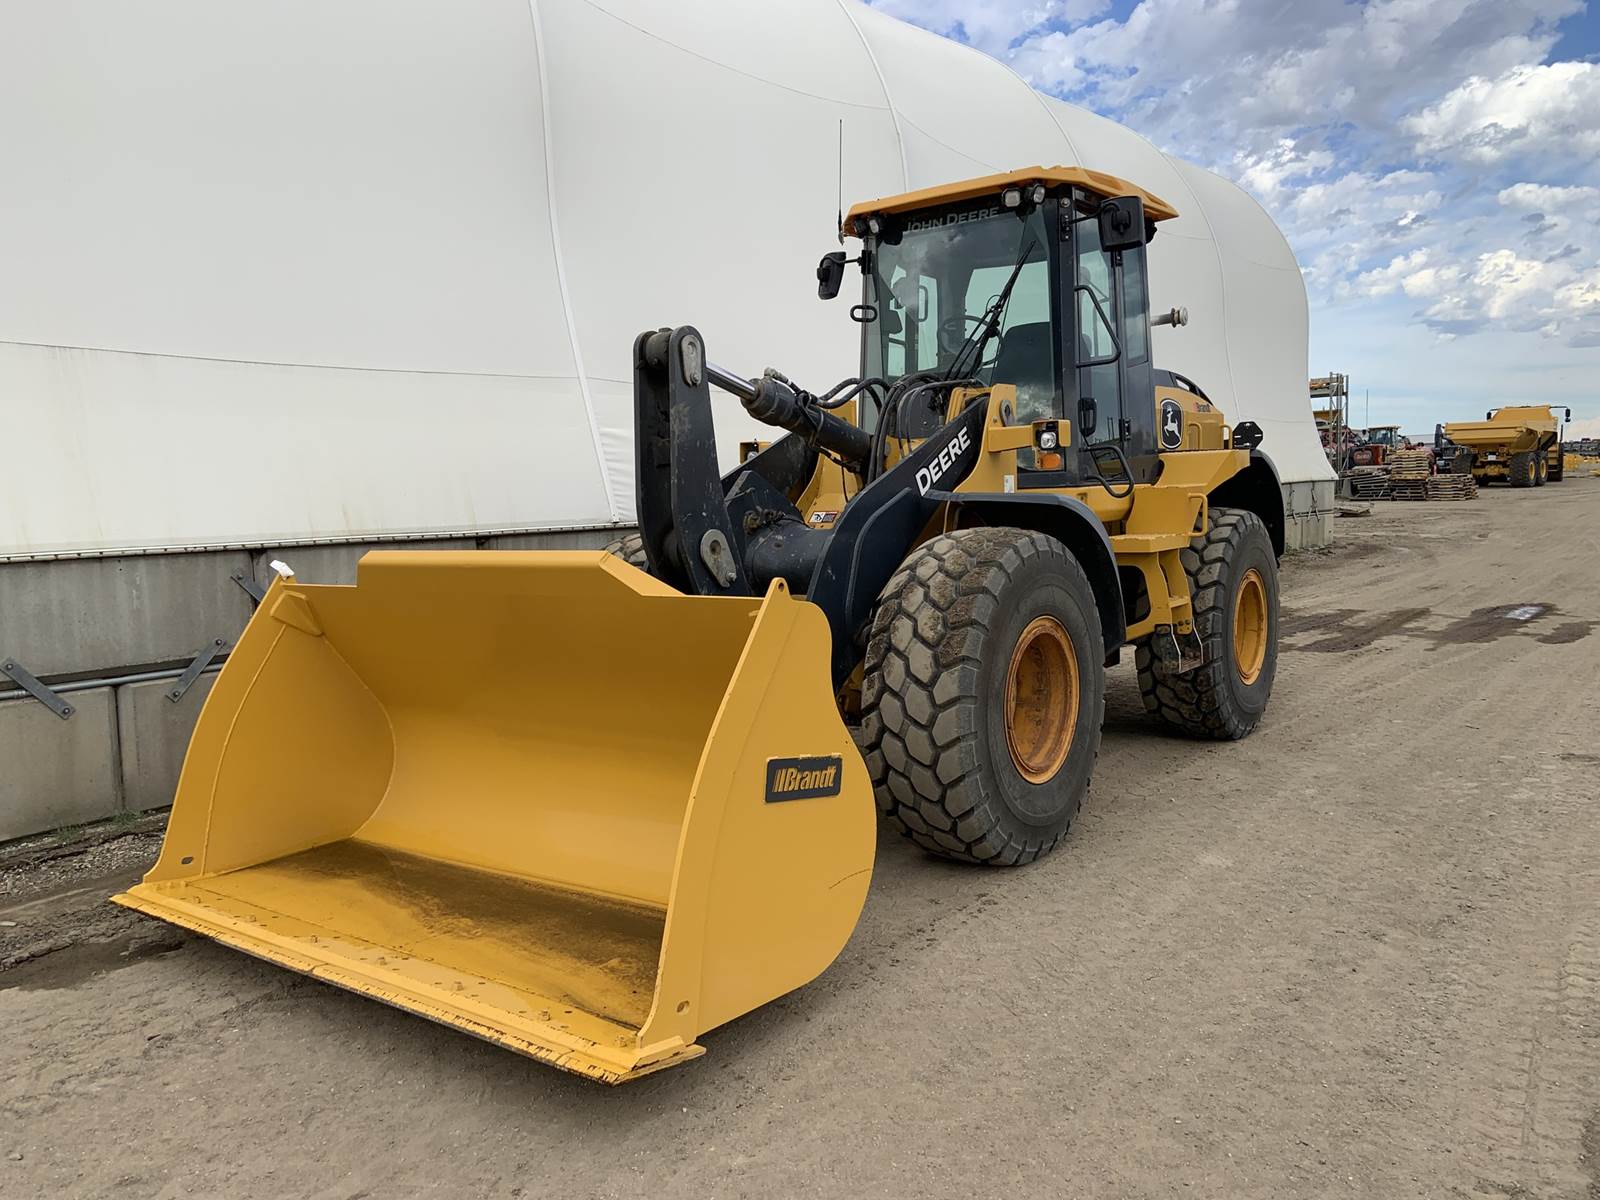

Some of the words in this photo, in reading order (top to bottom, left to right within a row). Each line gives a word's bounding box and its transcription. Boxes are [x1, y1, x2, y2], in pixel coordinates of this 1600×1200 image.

[907, 217, 943, 232] JOHN
[947, 206, 1000, 225] DEERE
[915, 426, 971, 497] DEERE
[780, 765, 836, 792] Brandt
